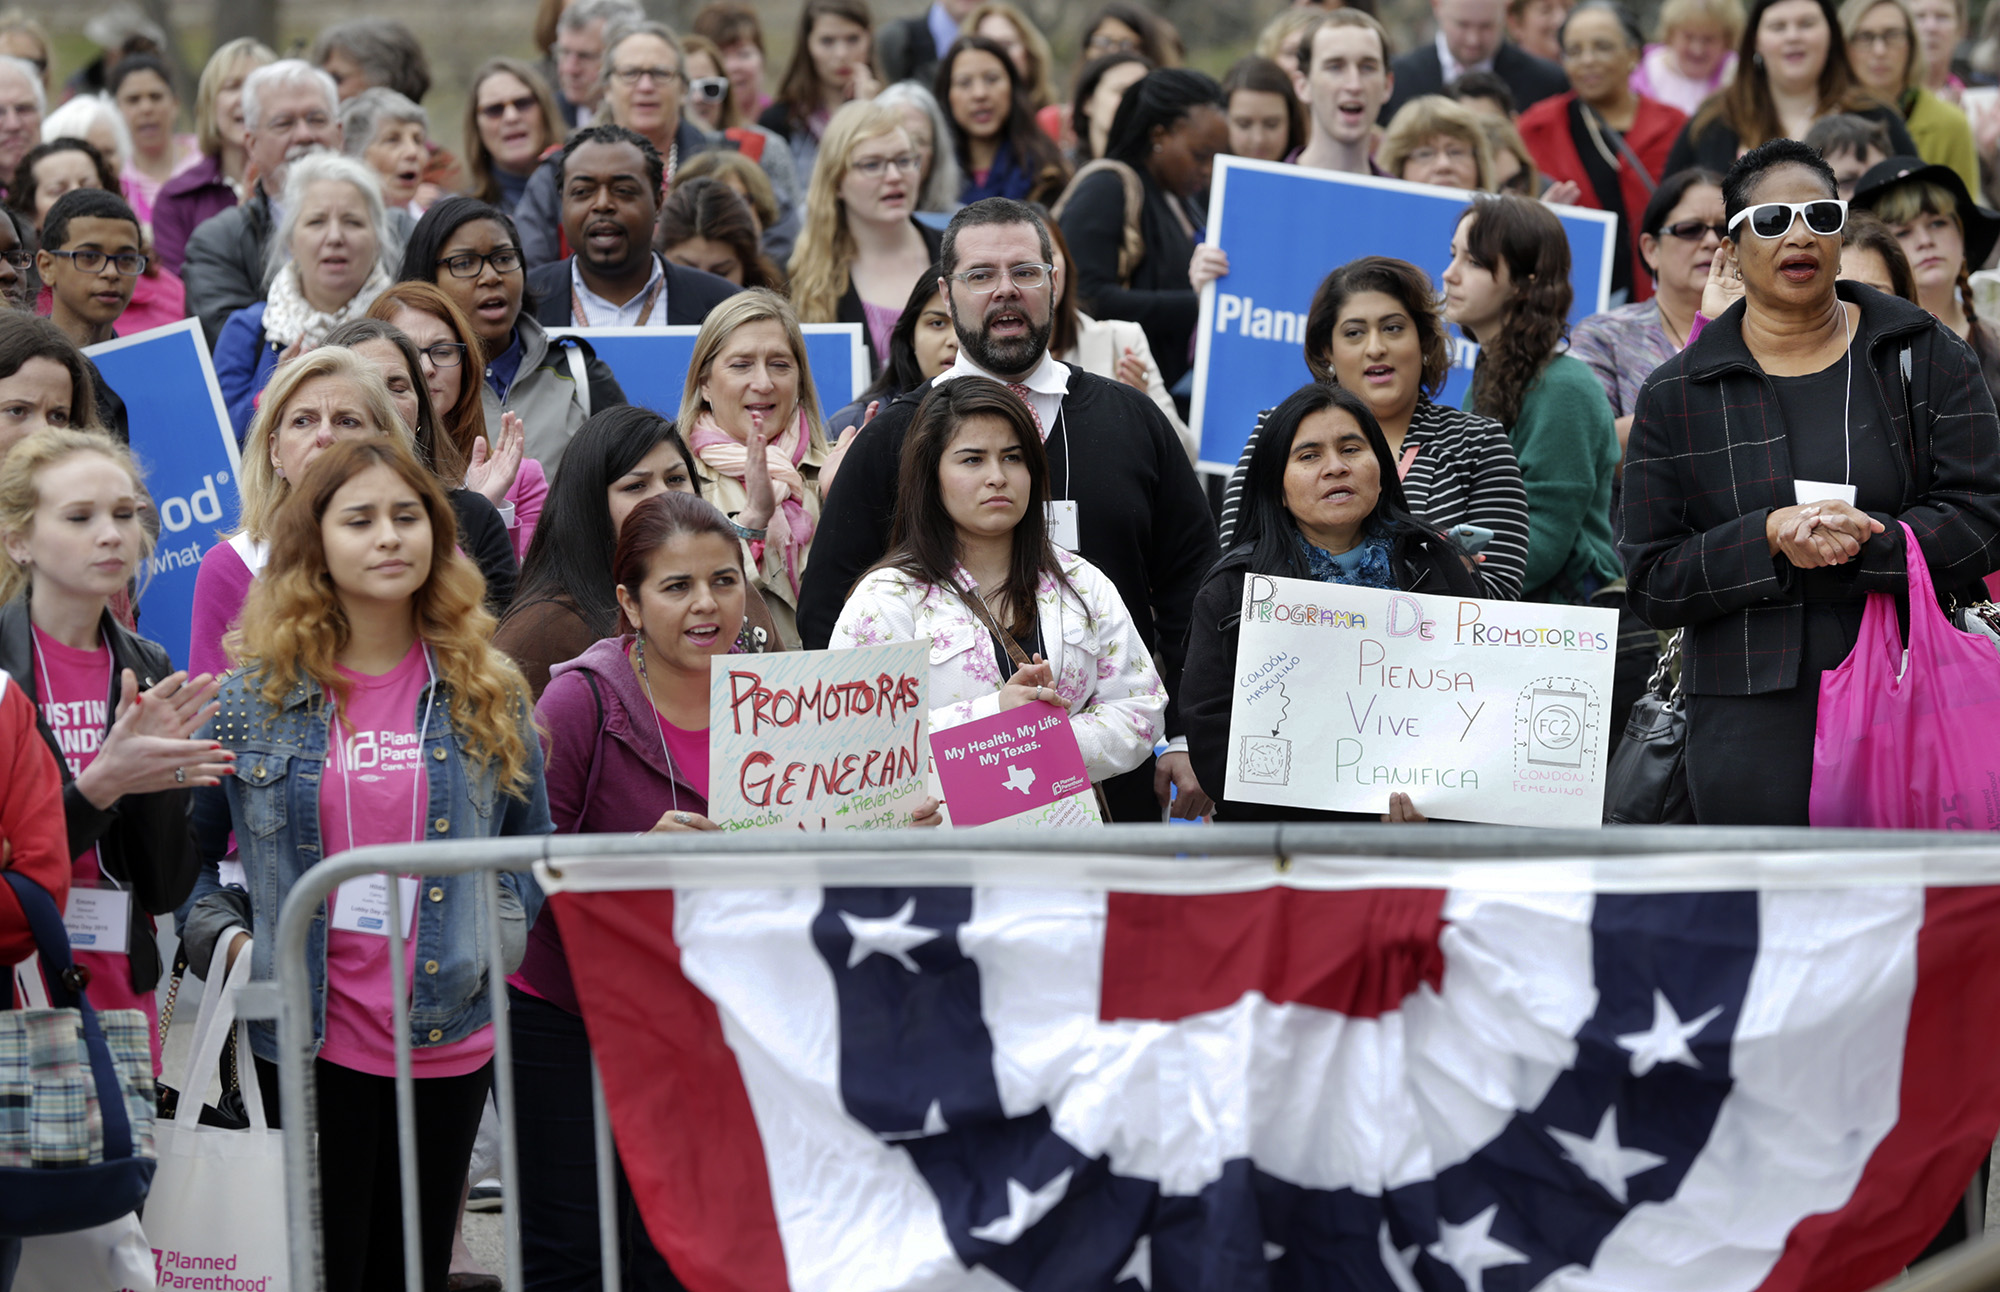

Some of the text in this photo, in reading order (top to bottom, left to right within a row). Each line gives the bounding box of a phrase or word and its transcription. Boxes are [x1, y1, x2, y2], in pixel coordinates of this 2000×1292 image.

[154, 541, 202, 575] what
[1246, 574, 1608, 652] PROGRAMA DE PROMOTORAS
[1240, 651, 1288, 688] CONDÓN
[1246, 656, 1300, 706] MASCULINO
[1359, 639, 1474, 692] PIENSA
[729, 671, 919, 737] PROMOTORAS
[1346, 692, 1485, 742] VIVE Y
[944, 715, 1061, 761] My Health, My Life.
[1540, 719, 1571, 735] FC2
[740, 719, 919, 809] GENERAN
[979, 741, 1041, 767] My Texas.
[1336, 738, 1479, 789] PLANIFICA
[1512, 781, 1584, 796] FEMENINO
[1519, 768, 1585, 782] CONDÓN
[852, 778, 922, 814] Prevención
[165, 1251, 237, 1271] Planned
